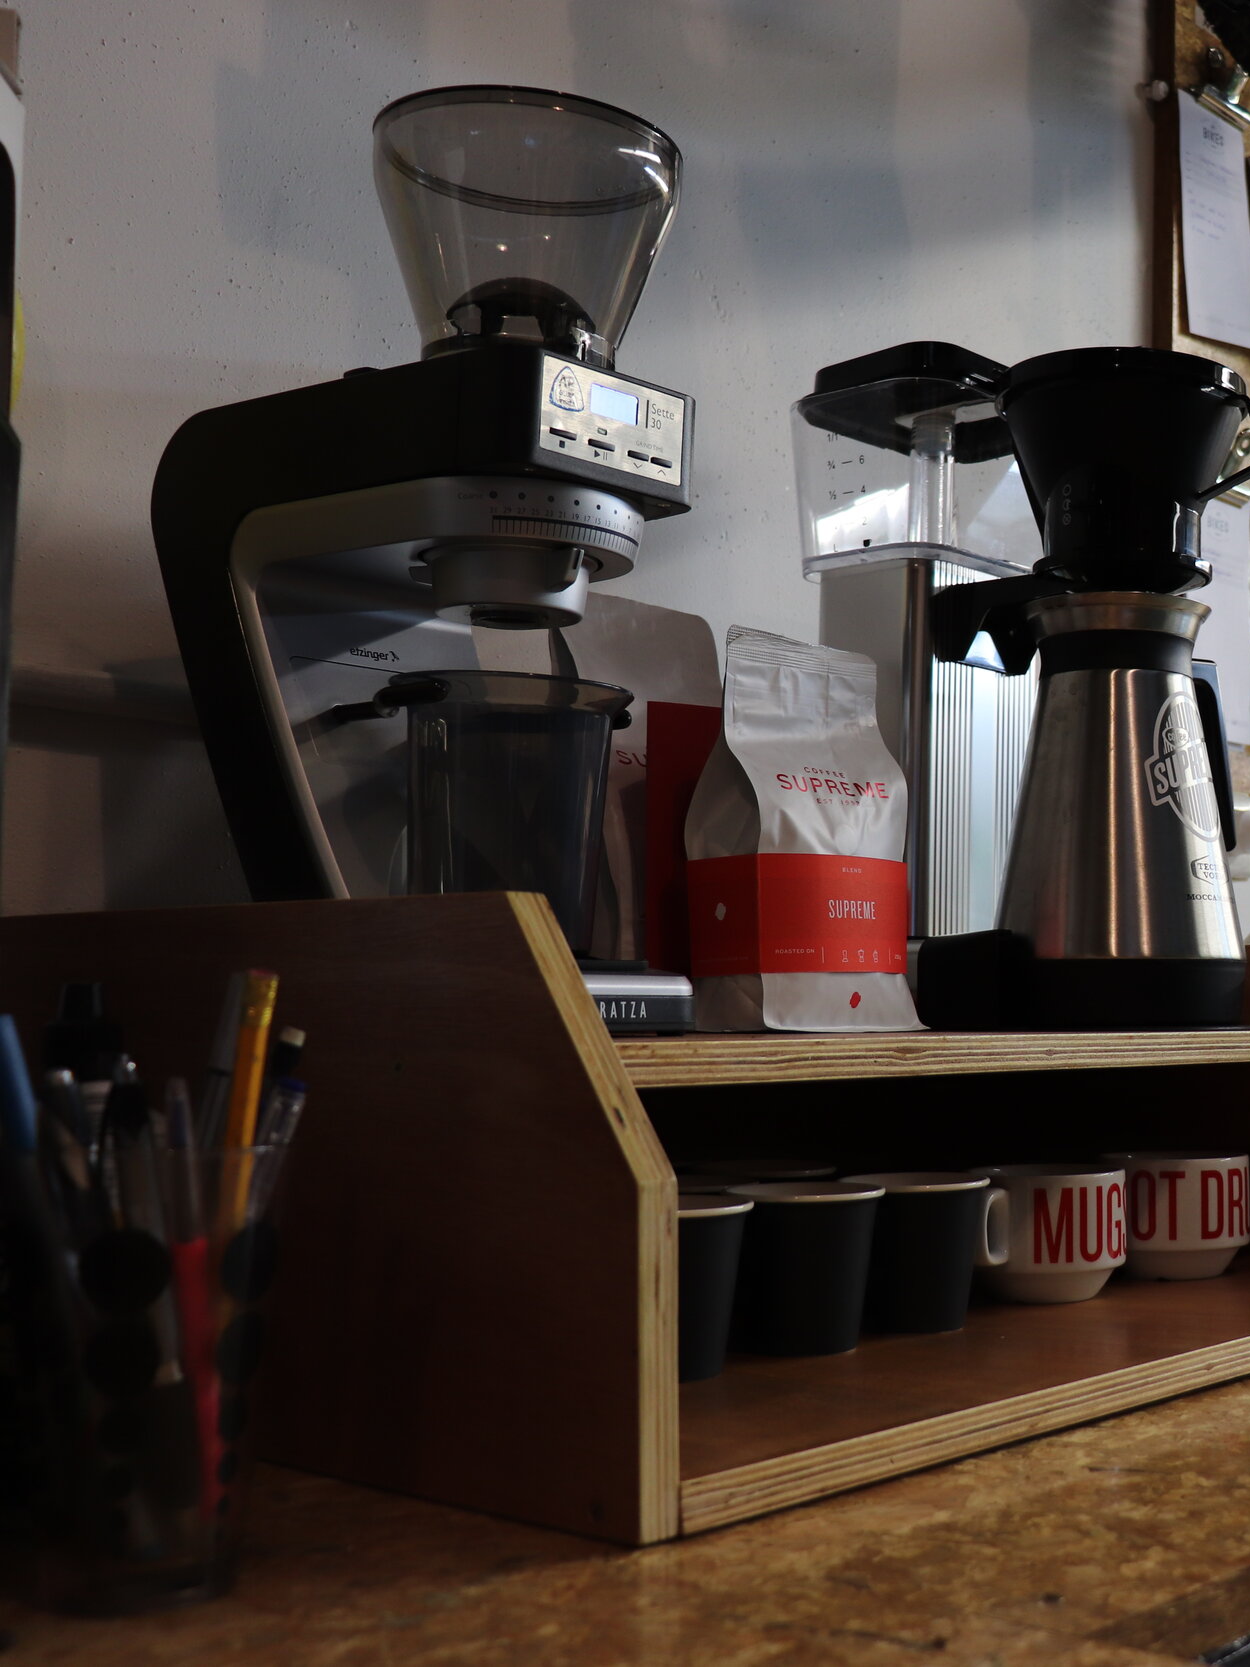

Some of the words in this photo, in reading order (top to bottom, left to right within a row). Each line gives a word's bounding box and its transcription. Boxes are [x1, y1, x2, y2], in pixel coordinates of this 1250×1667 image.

[651, 403, 675, 420] Sette
[651, 417, 661, 430] 30
[859, 454, 865, 465] 6
[860, 484, 866, 493] 4
[803, 766, 845, 779] COFFEE
[776, 773, 889, 799] SUPREME
[828, 899, 876, 920] SUPREME
[600, 1000, 647, 1019] RATZA
[1131, 1169, 1186, 1241] OT
[1033, 1182, 1127, 1264] MUG
